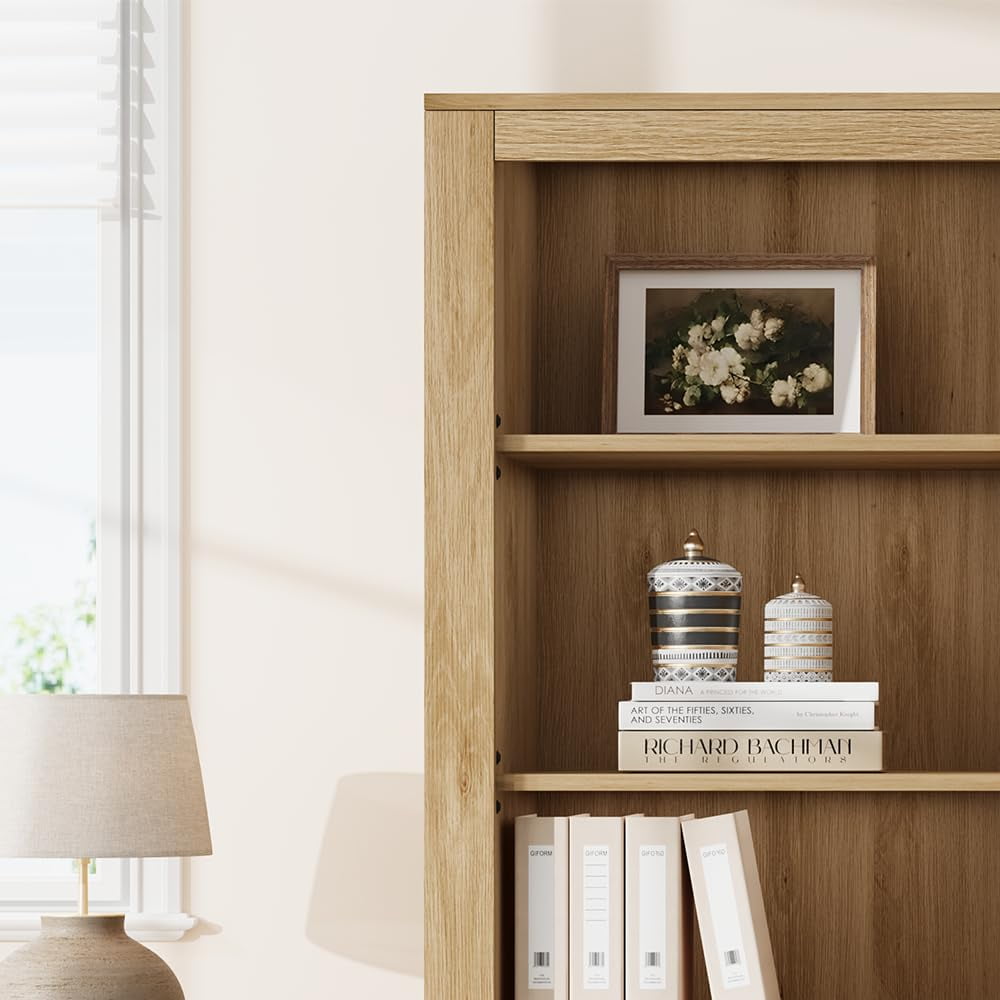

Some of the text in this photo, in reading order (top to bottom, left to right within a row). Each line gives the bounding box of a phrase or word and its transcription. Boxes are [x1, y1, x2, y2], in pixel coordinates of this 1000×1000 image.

[654, 685, 693, 696] DIANA
[631, 706, 754, 716] ART OF THE FIFTIES, SIXTIES,
[631, 716, 702, 724] AND SEVENTIES
[644, 738, 851, 755] RICHARD BACHMAN
